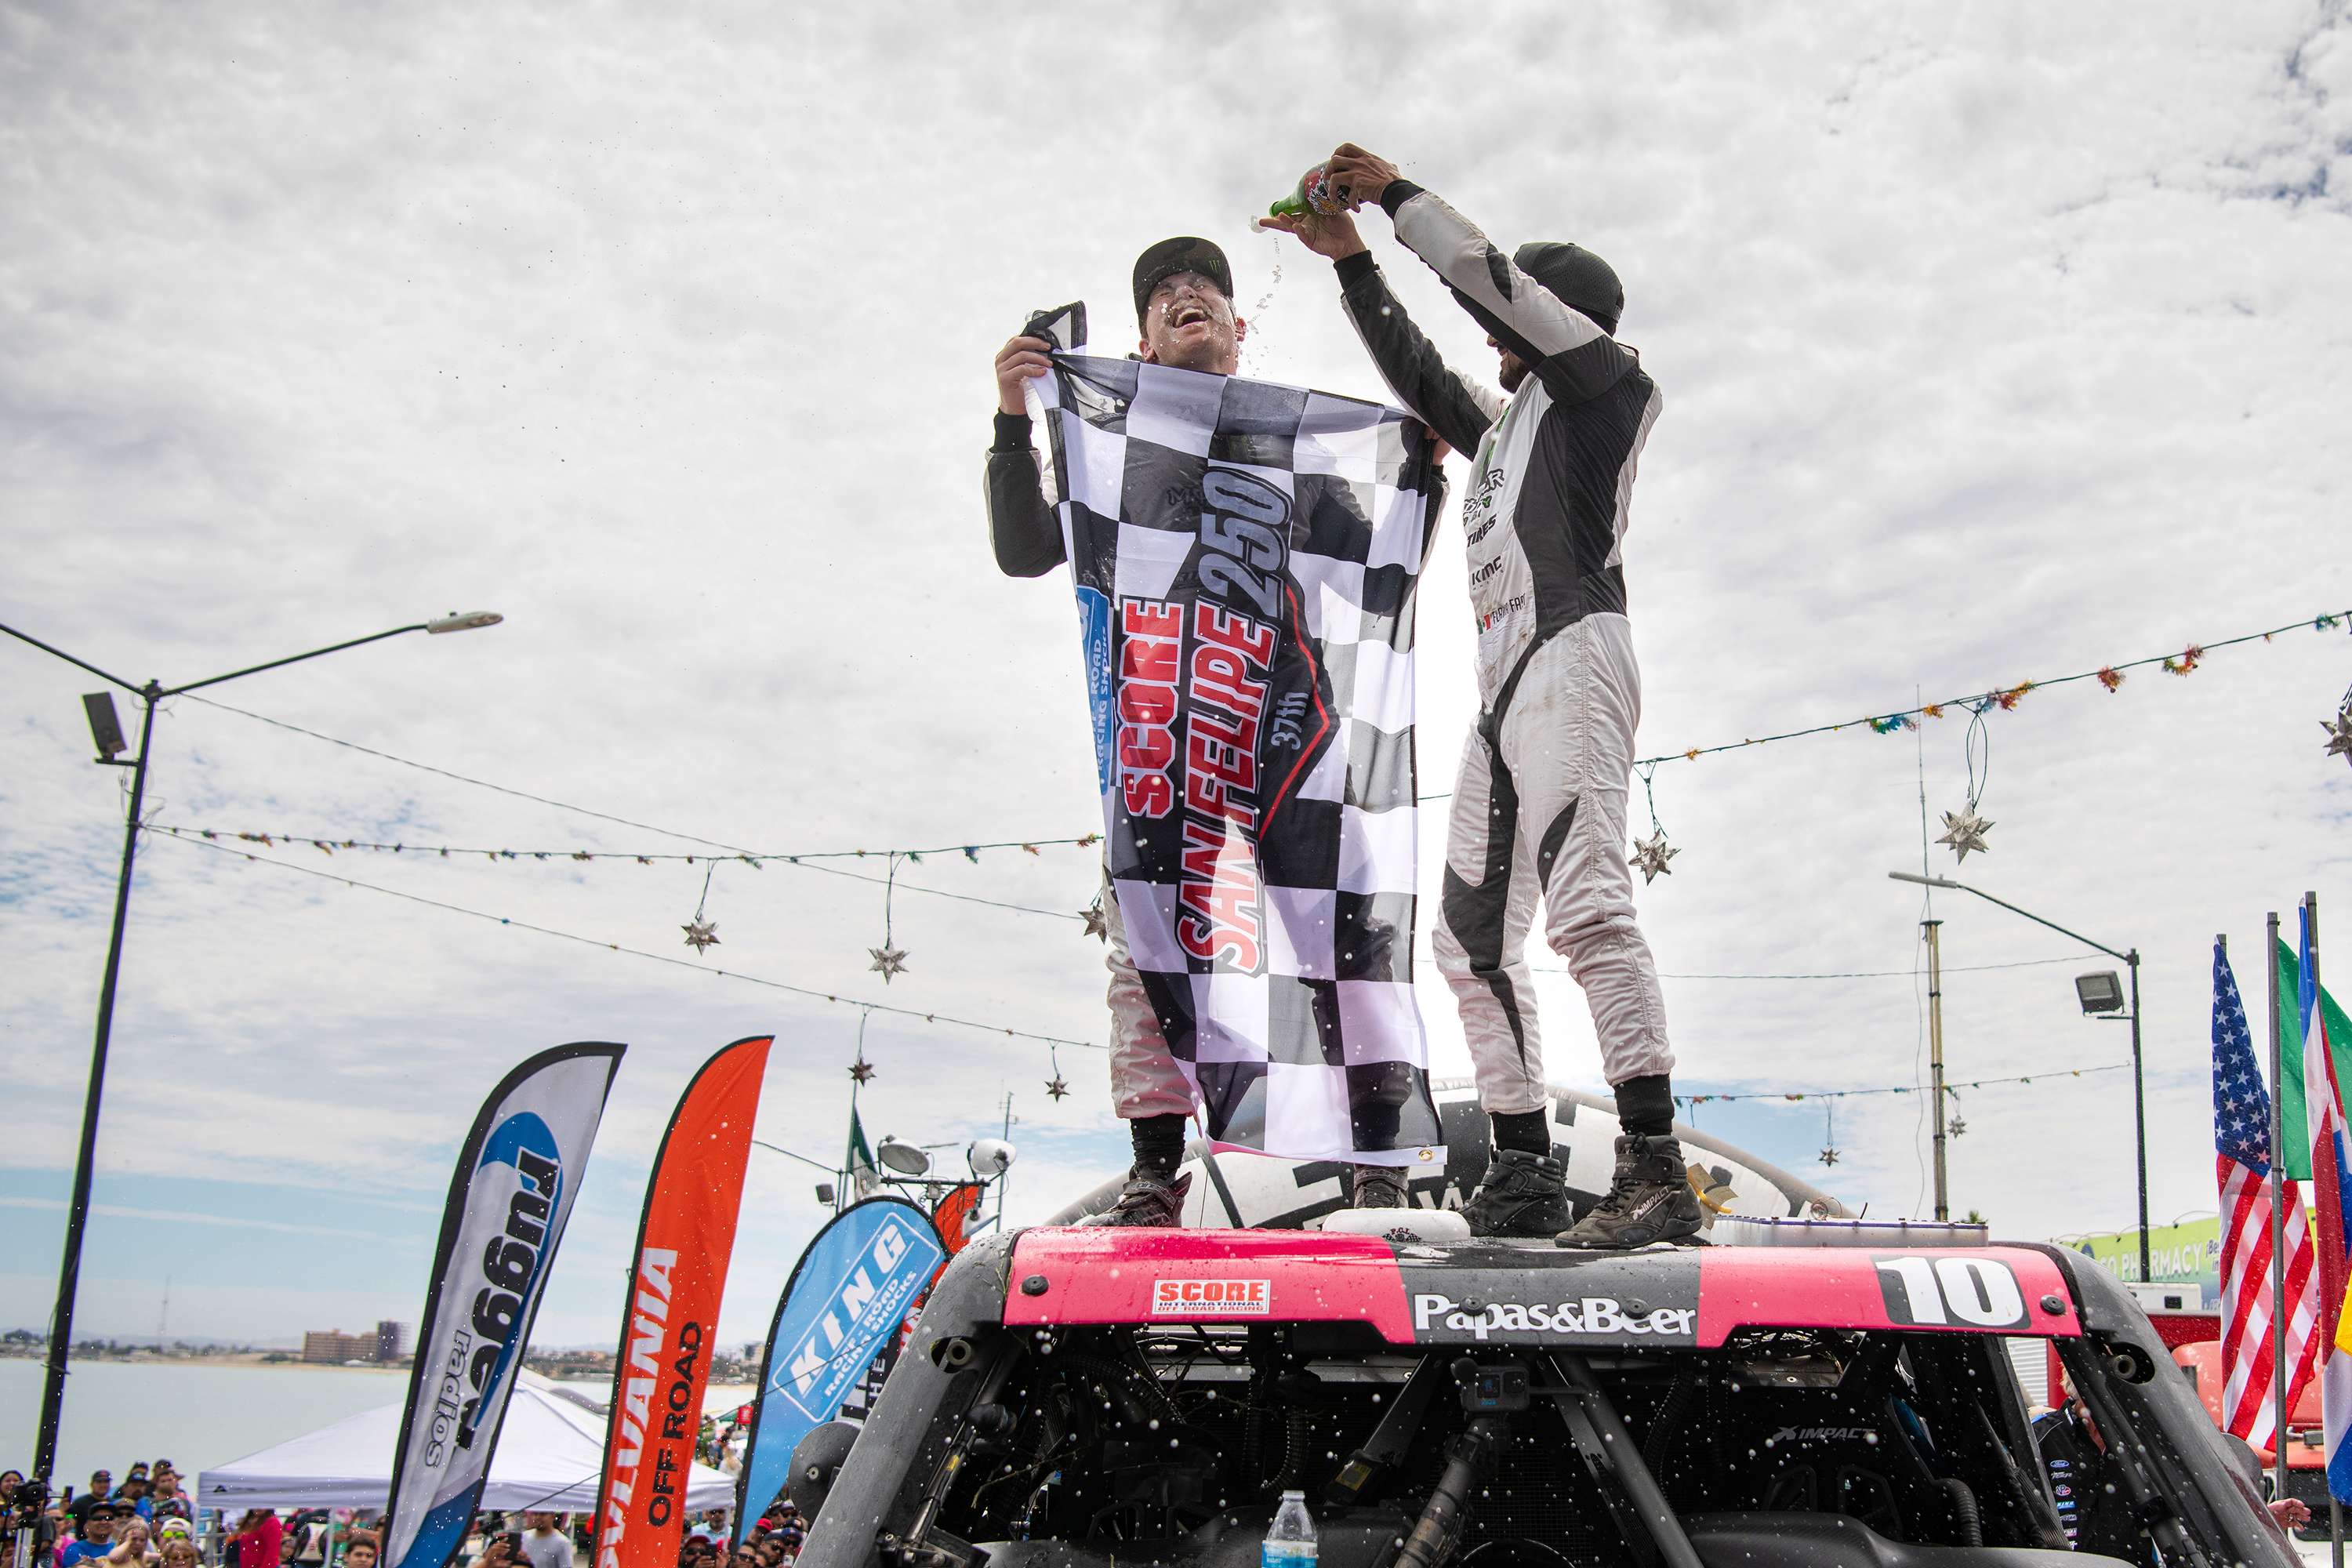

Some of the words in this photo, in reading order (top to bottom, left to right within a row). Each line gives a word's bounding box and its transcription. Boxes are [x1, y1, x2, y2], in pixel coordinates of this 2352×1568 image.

[1197, 466, 1290, 619] 250
[1467, 513, 1497, 547] TIRES
[1091, 639, 1102, 695] ROAD
[1117, 598, 1185, 820] SCORE
[1185, 594, 1279, 831] FELIPE
[1271, 691, 1308, 750] 37th
[1175, 819, 1265, 977] SAN
[1639, 1185, 1670, 1214] IMPACT
[1159, 1282, 1264, 1301] SCORE
[1875, 1257, 2024, 1327] 10
[2122, 1243, 2203, 1279] PHRMACY
[790, 1224, 906, 1396] KING
[824, 1334, 871, 1397] RACING
[871, 1270, 916, 1333] SHOCKS
[832, 1338, 857, 1370] OFF
[863, 1279, 898, 1327] ROAD
[1414, 1293, 1697, 1341] Papas&Beer
[424, 1330, 471, 1468] radios
[662, 1320, 703, 1440] ROAD
[1798, 1427, 1877, 1440] IMPACT
[648, 1448, 679, 1527] OFF
